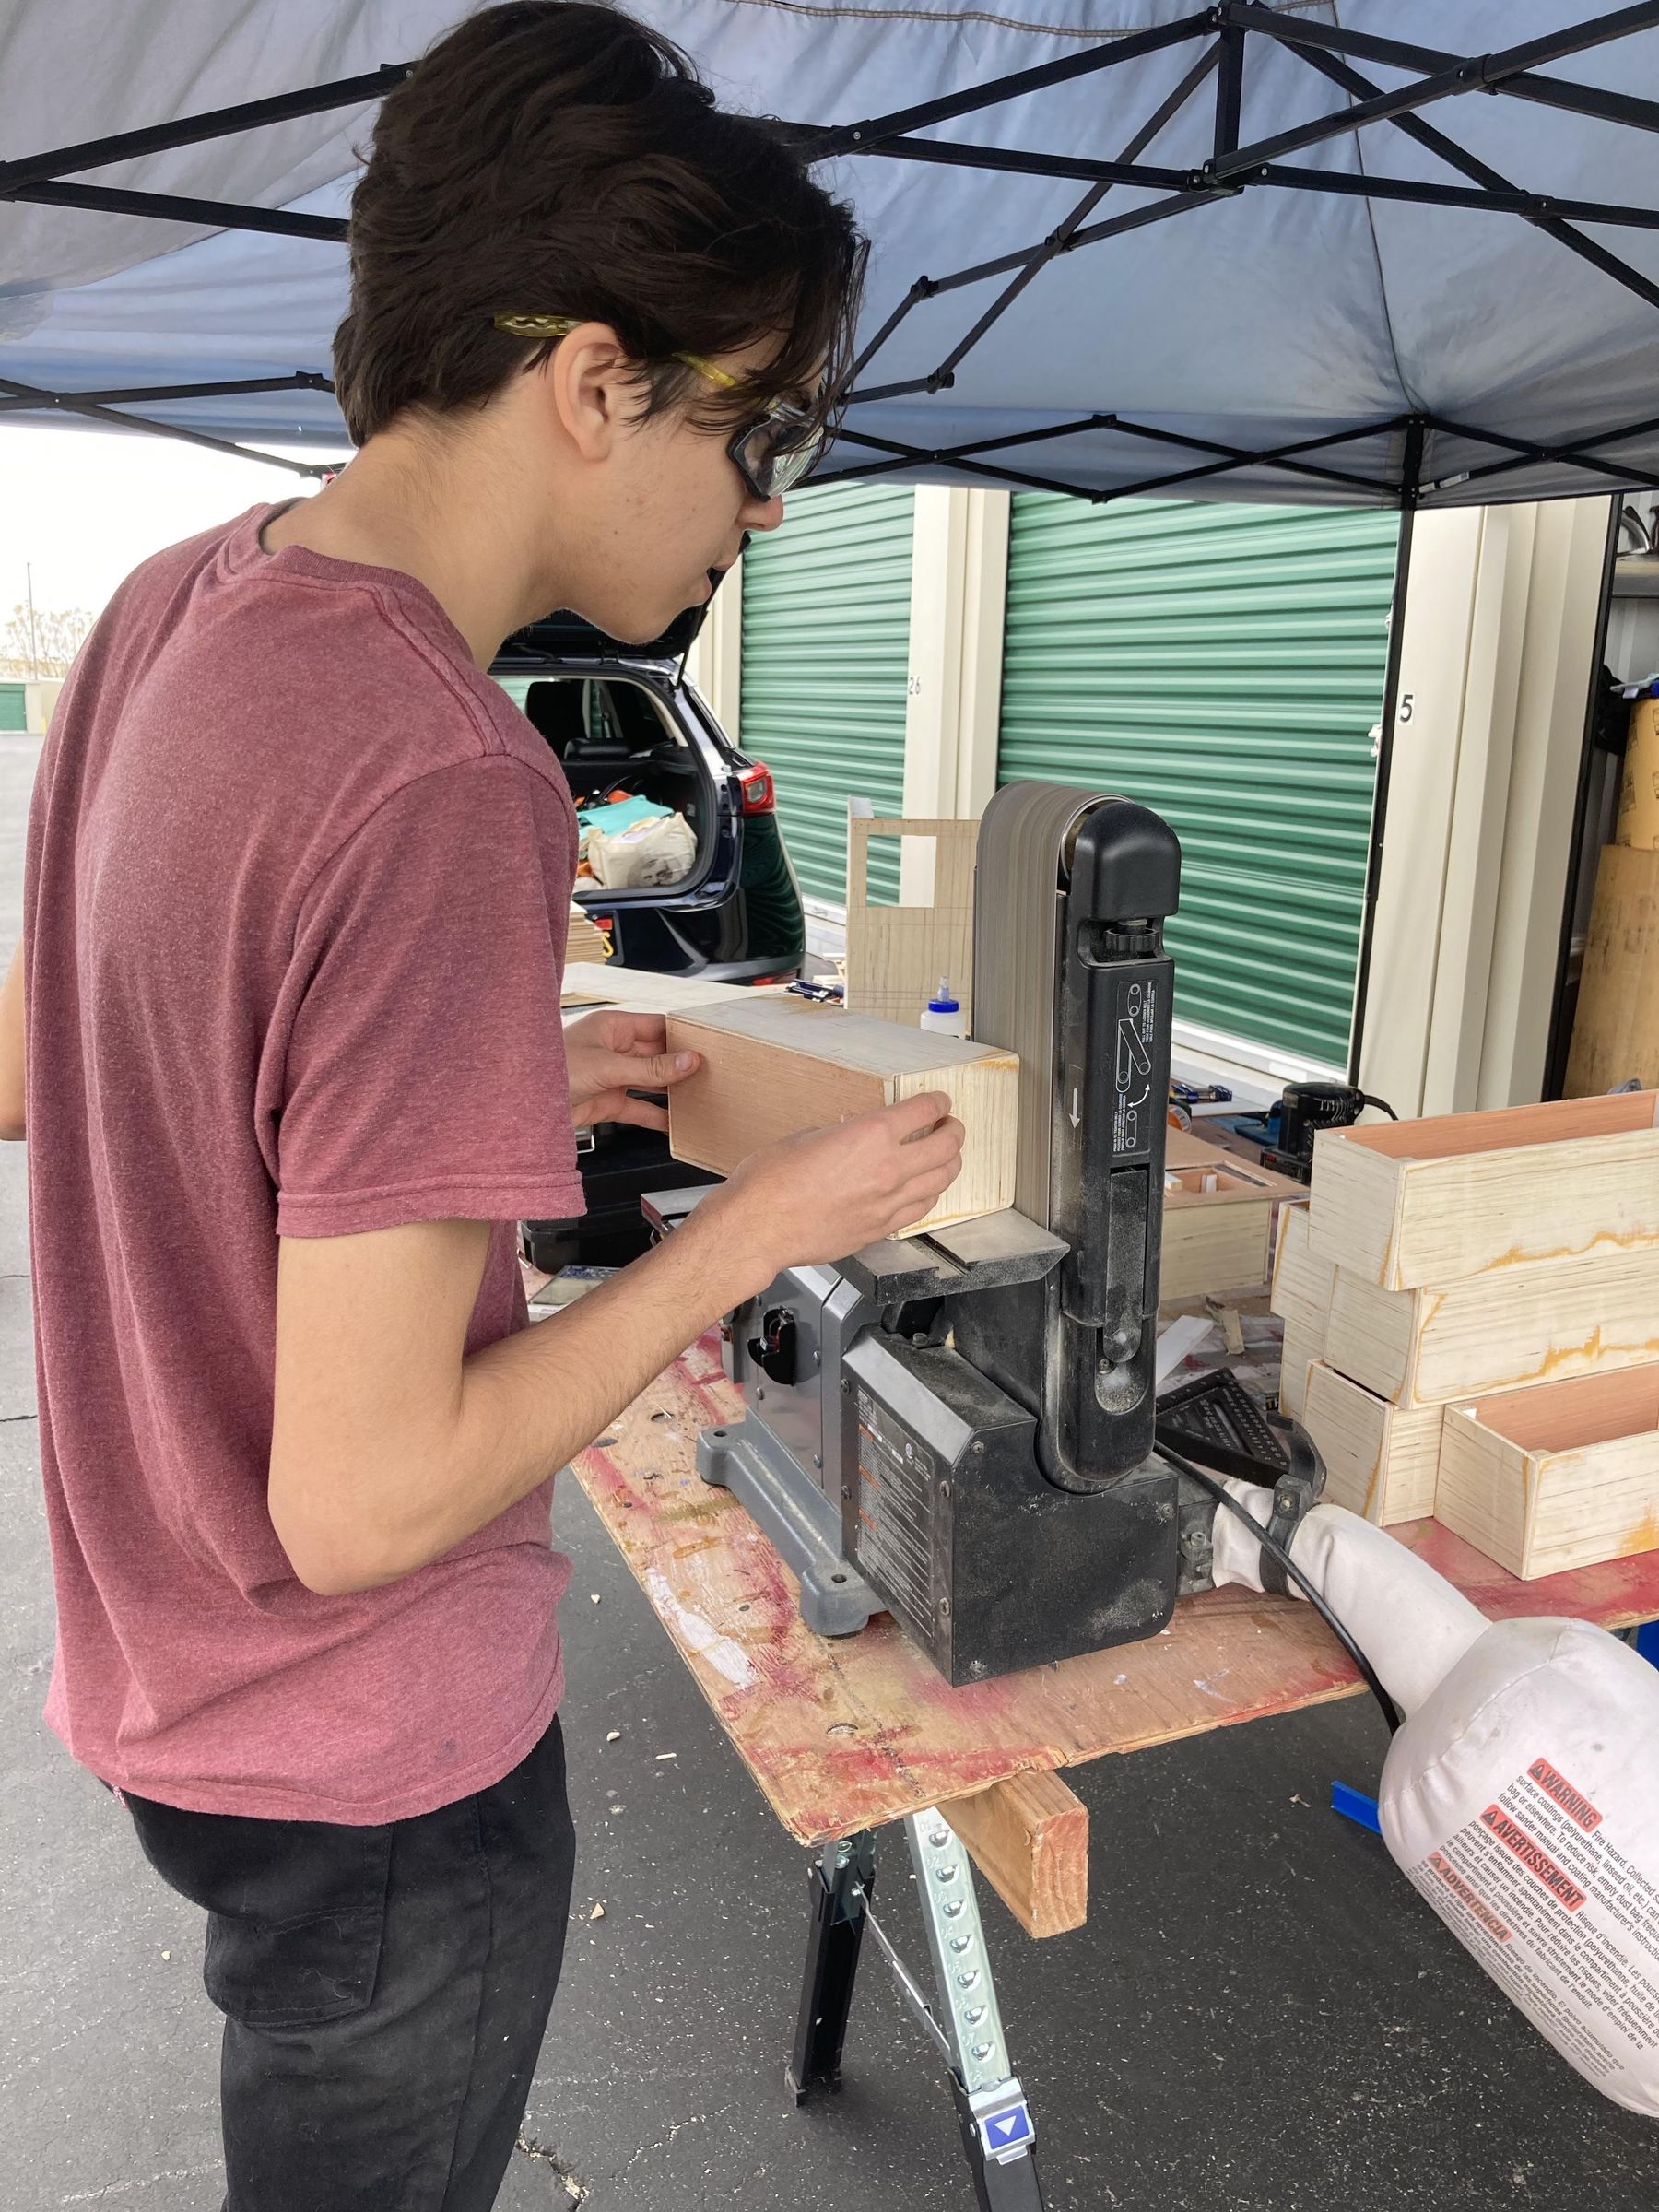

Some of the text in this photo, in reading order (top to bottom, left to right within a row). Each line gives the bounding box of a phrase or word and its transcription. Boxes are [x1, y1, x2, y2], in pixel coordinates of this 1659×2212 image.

[1492, 1819, 1584, 1907] AVERTISSEMENT
[1497, 1792, 1518, 1813] follow
[1514, 1810, 1537, 1831] sander
[1535, 1830, 1559, 1853] manual
[1556, 1852, 1571, 1865] and
[1567, 1864, 1591, 1888] coating
[1588, 1885, 1634, 1931] manufacturer's
[1506, 1783, 1521, 1799] bag
[1518, 1795, 1528, 1805] or
[1524, 1803, 1556, 1836] elsewhere.
[1556, 1831, 1566, 1843] To
[1563, 1841, 1586, 1864] reduce
[1583, 1861, 1598, 1878] risk,
[1597, 1875, 1618, 1897] empty
[1616, 1894, 1632, 1910] dust
[1629, 1906, 1643, 1923] bag
[1515, 1775, 1659, 1920] surface coatings (polyurethane, linseed oil, etc.) can
[1539, 1770, 1597, 1829] WARNING
[1591, 1830, 1606, 1846] Fire
[1603, 1842, 1628, 1868] Hazard.
[1626, 1865, 1656, 1896] Collected
[1438, 1868, 1507, 1941] ADVERTENCIA
[1439, 1844, 1466, 1875] ponceuse
[1465, 1874, 1481, 1889] ainsi
[1478, 1888, 1491, 1900] que
[1489, 1900, 1500, 1911] les
[1499, 1910, 1527, 1940] directives
[1525, 1939, 1535, 1948] du
[1534, 1947, 1562, 1976] fabricant
[1559, 1975, 1569, 1984] de
[1445, 1839, 1453, 1847] le
[1452, 1846, 1492, 1888] compartiment
[1527, 1927, 1547, 1947] suivre
[1546, 1946, 1581, 1983] strictement
[1578, 1980, 1586, 1988] le
[1584, 1987, 1603, 2006] mode
[1627, 2032, 1637, 2041] de
[1635, 2041, 1643, 2050] la
[1453, 1833, 1475, 1856] ailleurs
[1473, 1855, 1483, 1864] et
[1480, 1863, 1501, 1883] causer
[1500, 1882, 1510, 1892] un
[1507, 1889, 1534, 1919] incendie.
[1534, 1917, 1550, 1934] Pour
[1547, 1933, 1571, 1956] réduire
[1569, 1954, 1580, 1966] les
[1578, 1965, 1601, 1992] risques,
[1601, 1989, 1619, 2006] vider
[1459, 1827, 1486, 1853] peuvent
[1483, 1850, 1521, 1887] s'enflammer
[1518, 1886, 1560, 1930] spontanément
[1558, 1928, 1575, 1945] dans
[1572, 1942, 1581, 1951] le
[1579, 1950, 1622, 1994] compartiment
[1622, 1997, 1654, 2029] poussière
[1467, 1820, 1495, 1846] ponçage
[1493, 1843, 1514, 1865] issues
[1512, 1864, 1524, 1877] des
[1523, 1875, 1549, 1901] couches
[1547, 1900, 1558, 1910] de
[1553, 1908, 1586, 1940] protection
[1629, 1983, 1646, 2003] huile
[1644, 2001, 1654, 2011] de
[1575, 1910, 1597, 1934] Risque
[1595, 1933, 1628, 1968] d'incendie.
[1627, 1964, 1641, 1980] Les
